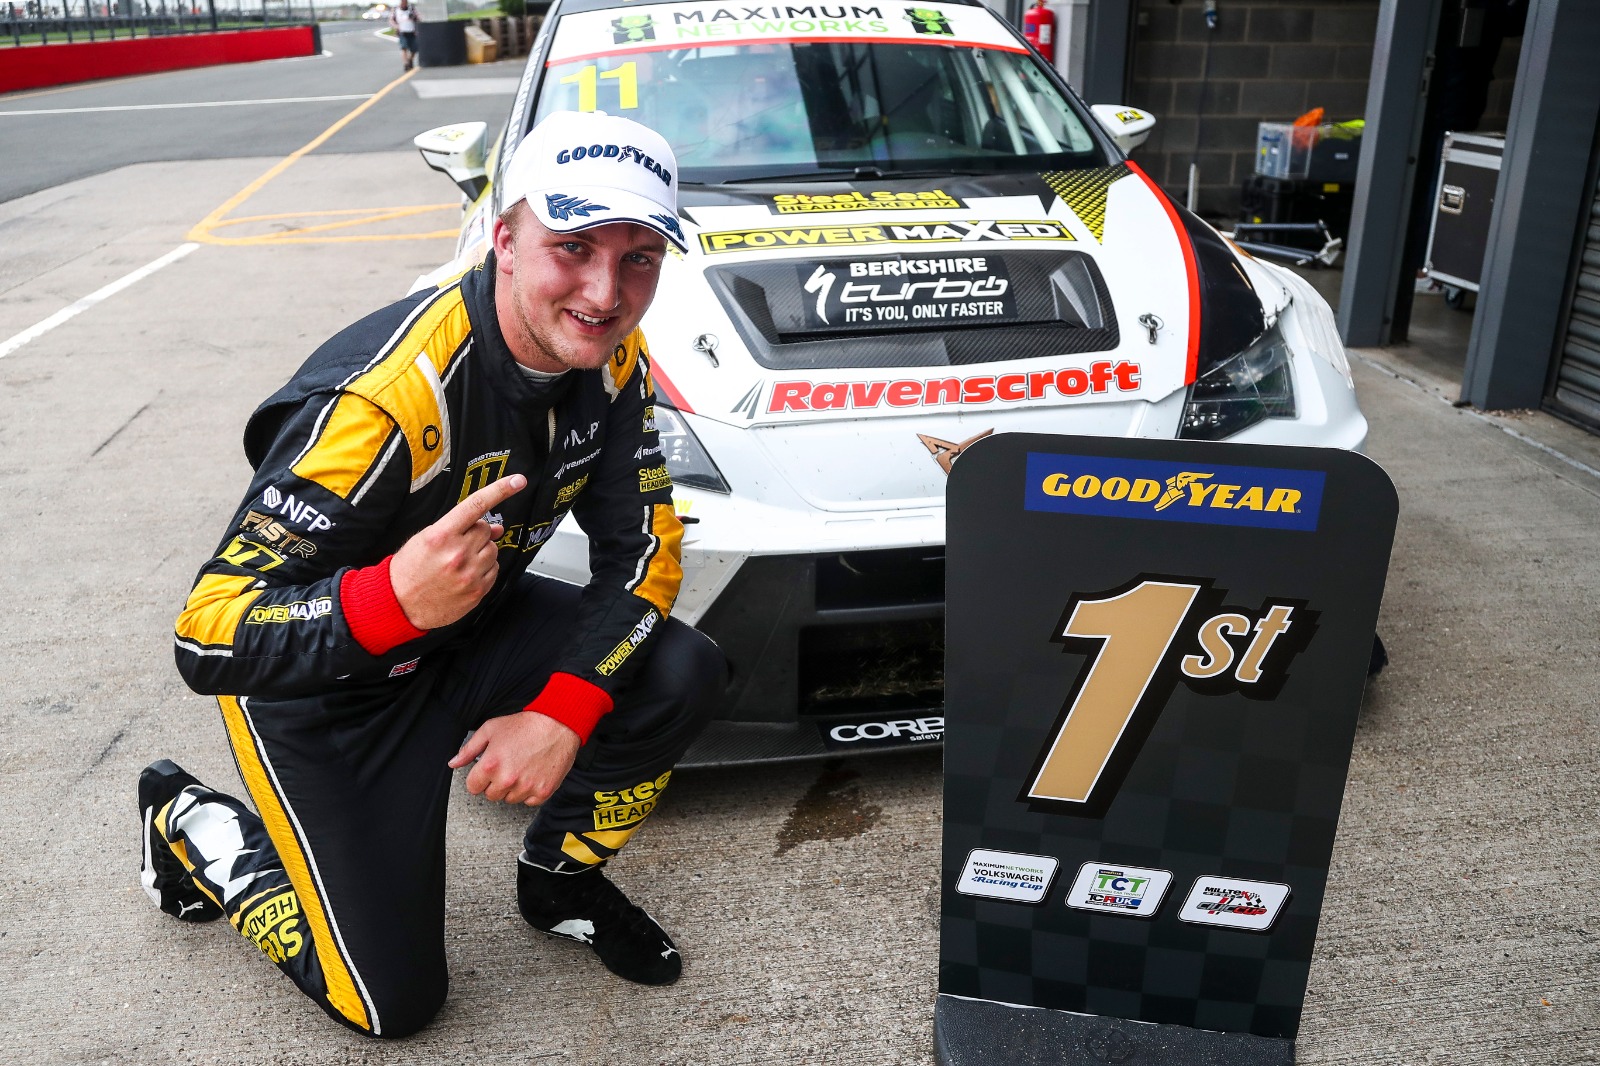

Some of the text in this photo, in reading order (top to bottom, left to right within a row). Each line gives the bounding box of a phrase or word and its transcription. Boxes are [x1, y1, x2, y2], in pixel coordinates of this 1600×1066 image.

[674, 6, 884, 25] MAXIMUM
[676, 19, 889, 38] NETWORKS
[560, 61, 638, 113] 11
[773, 189, 952, 205] Steel Seal
[782, 203, 836, 212] HEAD
[841, 201, 916, 210] GASKET
[710, 220, 1061, 250] POWER MAXED
[850, 257, 988, 277] BERKSHIRE
[839, 275, 1009, 303] turbo
[845, 301, 1004, 322] IT'S YOU, ONLY FASTER
[766, 360, 1142, 414] Ravenscroft
[281, 494, 332, 532] NFP
[600, 611, 657, 676] POWER MAXED
[1027, 580, 1295, 804] 1st
[830, 717, 945, 742] CORB
[909, 731, 941, 741] safety
[594, 769, 672, 808] Stee
[598, 802, 653, 825] HEAD
[973, 868, 1044, 883] VOLKSWAGEN
[974, 876, 1044, 891] Racing Cup
[1098, 874, 1148, 893] TCT
[249, 896, 293, 936] HEAD
[261, 918, 303, 964] Ste
